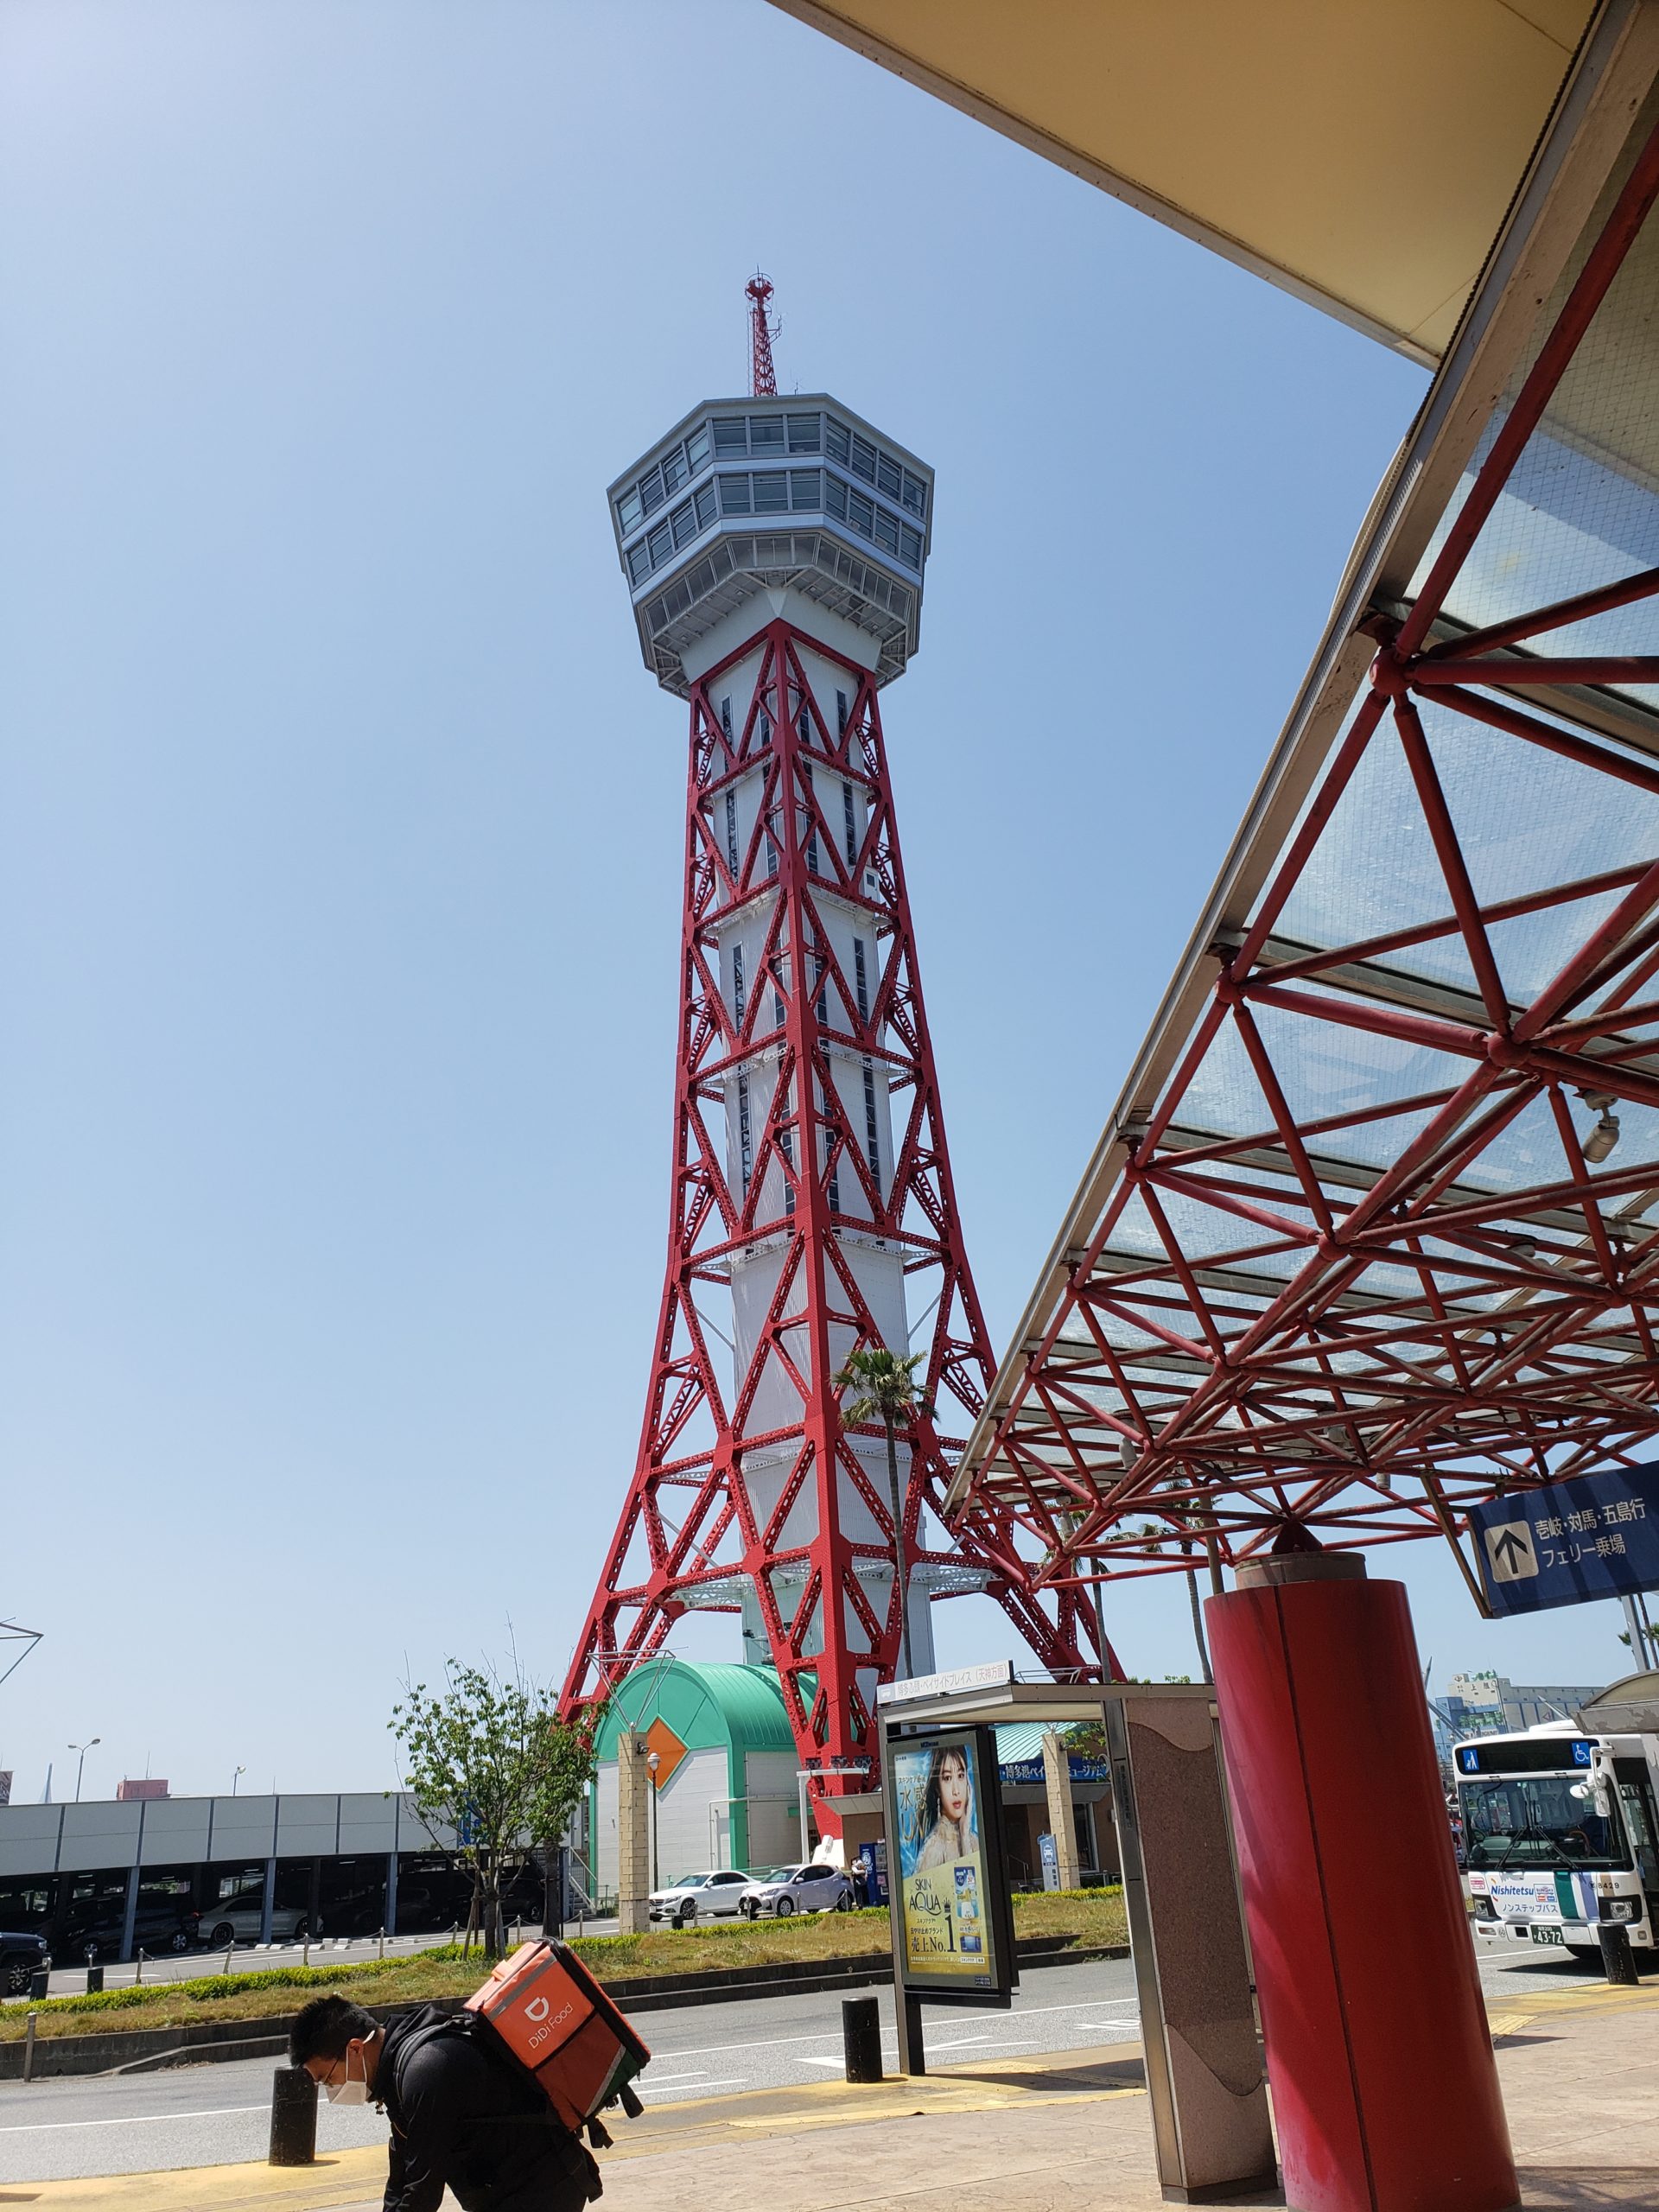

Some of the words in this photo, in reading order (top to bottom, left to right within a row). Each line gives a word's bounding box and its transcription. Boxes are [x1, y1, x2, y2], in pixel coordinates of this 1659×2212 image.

[1534, 1497, 1645, 1540] 壱岐・対馬・五島行
[1541, 1534, 1626, 1568] フェリー乗場
[915, 1878, 931, 1891] SKIN
[1491, 1885, 1535, 1896] Nishitetsu
[909, 1891, 942, 1916] AQUA
[1503, 1904, 1559, 1913] ノンステップバス
[528, 2024, 551, 2049] DiDi
[548, 2002, 574, 2029] Food
